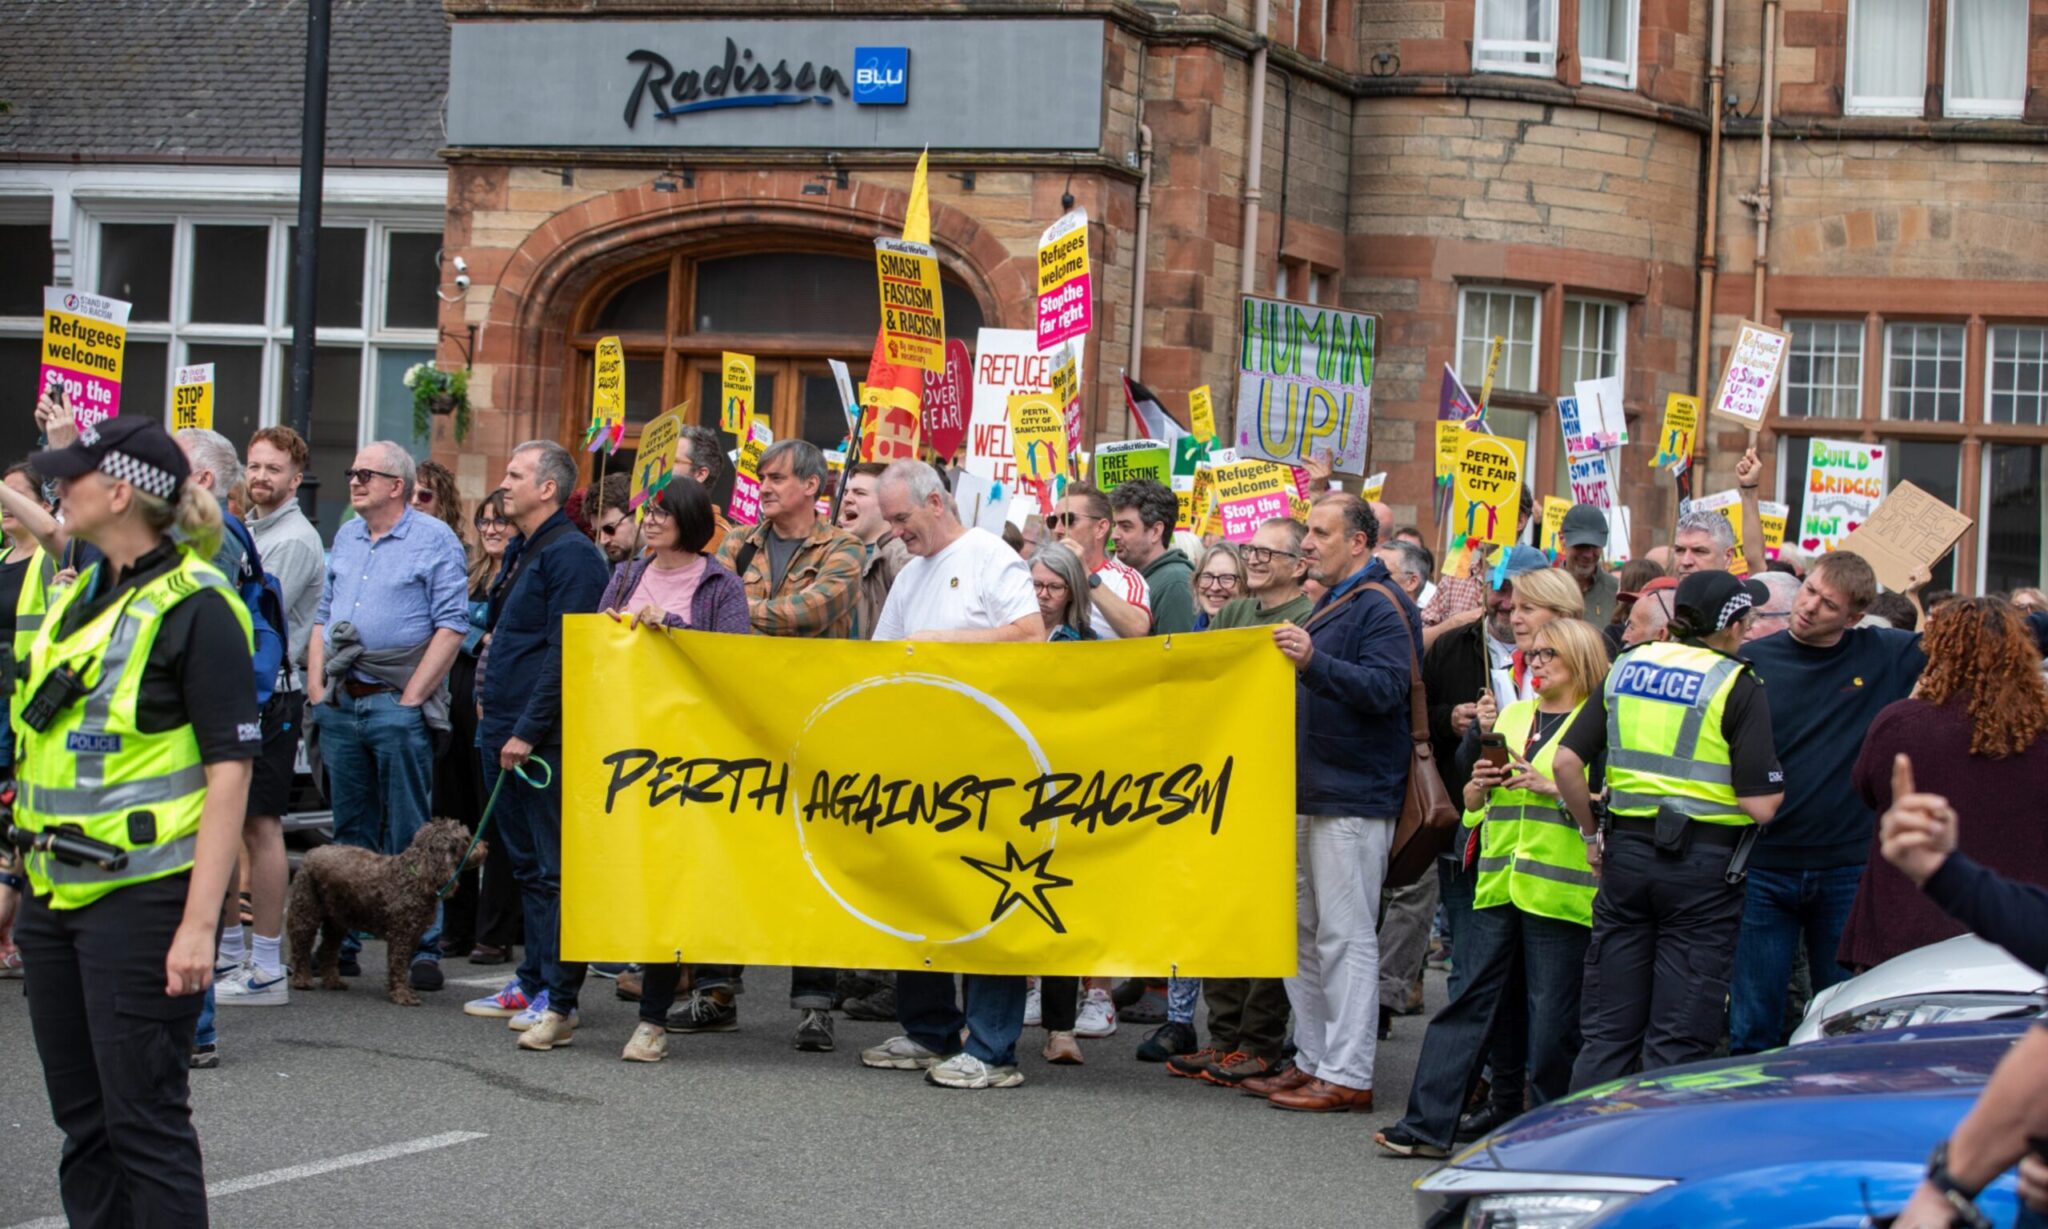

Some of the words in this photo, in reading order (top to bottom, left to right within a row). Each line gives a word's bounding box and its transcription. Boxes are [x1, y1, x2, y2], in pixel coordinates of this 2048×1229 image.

[624, 37, 850, 129] Radisson
[856, 68, 903, 86] BLU
[1041, 235, 1084, 268] Refugees
[881, 254, 921, 280] SMASH
[1041, 256, 1083, 287] welcome
[883, 282, 933, 309] FASCISM
[1040, 294, 1064, 315] Stop
[1064, 284, 1084, 307] the
[49, 315, 121, 349] Refugees
[886, 310, 896, 330] &
[899, 311, 942, 339] RACISM
[1040, 318, 1056, 335] far
[1240, 299, 1373, 387] HUMAN
[48, 343, 116, 372] welcome
[924, 361, 954, 386] OVE
[979, 354, 1053, 387] REFUGE
[86, 382, 112, 404] the
[177, 386, 204, 405] STOP
[923, 384, 957, 405] OVER
[177, 406, 196, 424] THE
[922, 405, 960, 430] FEAR
[1022, 408, 1048, 416] PERTH
[1559, 398, 1579, 419] NEV
[1015, 425, 1062, 434] SANCTUARY
[1042, 416, 1052, 424] OF
[1257, 378, 1354, 466] UP!
[1563, 420, 1581, 436] MIN
[1106, 442, 1134, 453] Socialist
[1134, 440, 1158, 450] Worker
[1812, 441, 1869, 470] BUILD
[1102, 454, 1128, 471] FREE
[1466, 449, 1509, 467] PERTH
[1103, 466, 1160, 485] PALESTINE
[1216, 463, 1279, 482] Refugees
[1460, 462, 1484, 476] THE
[1487, 467, 1517, 482] FAIR
[1571, 462, 1590, 480] STOP
[1592, 459, 1606, 475] THE
[1220, 478, 1279, 497] welcome
[1469, 478, 1500, 493] CITY
[1810, 469, 1881, 499] BRIDGES
[1572, 481, 1611, 509] YACHTS
[1223, 503, 1255, 520] Stop
[1257, 498, 1280, 513] the
[1226, 520, 1247, 535] far
[1806, 515, 1842, 535] NOT
[1617, 664, 1700, 700] POLICE
[69, 735, 117, 750] POLICE
[603, 748, 787, 814] PERTH
[802, 770, 1017, 834] AGAINST
[1019, 755, 1234, 835] RACISM
